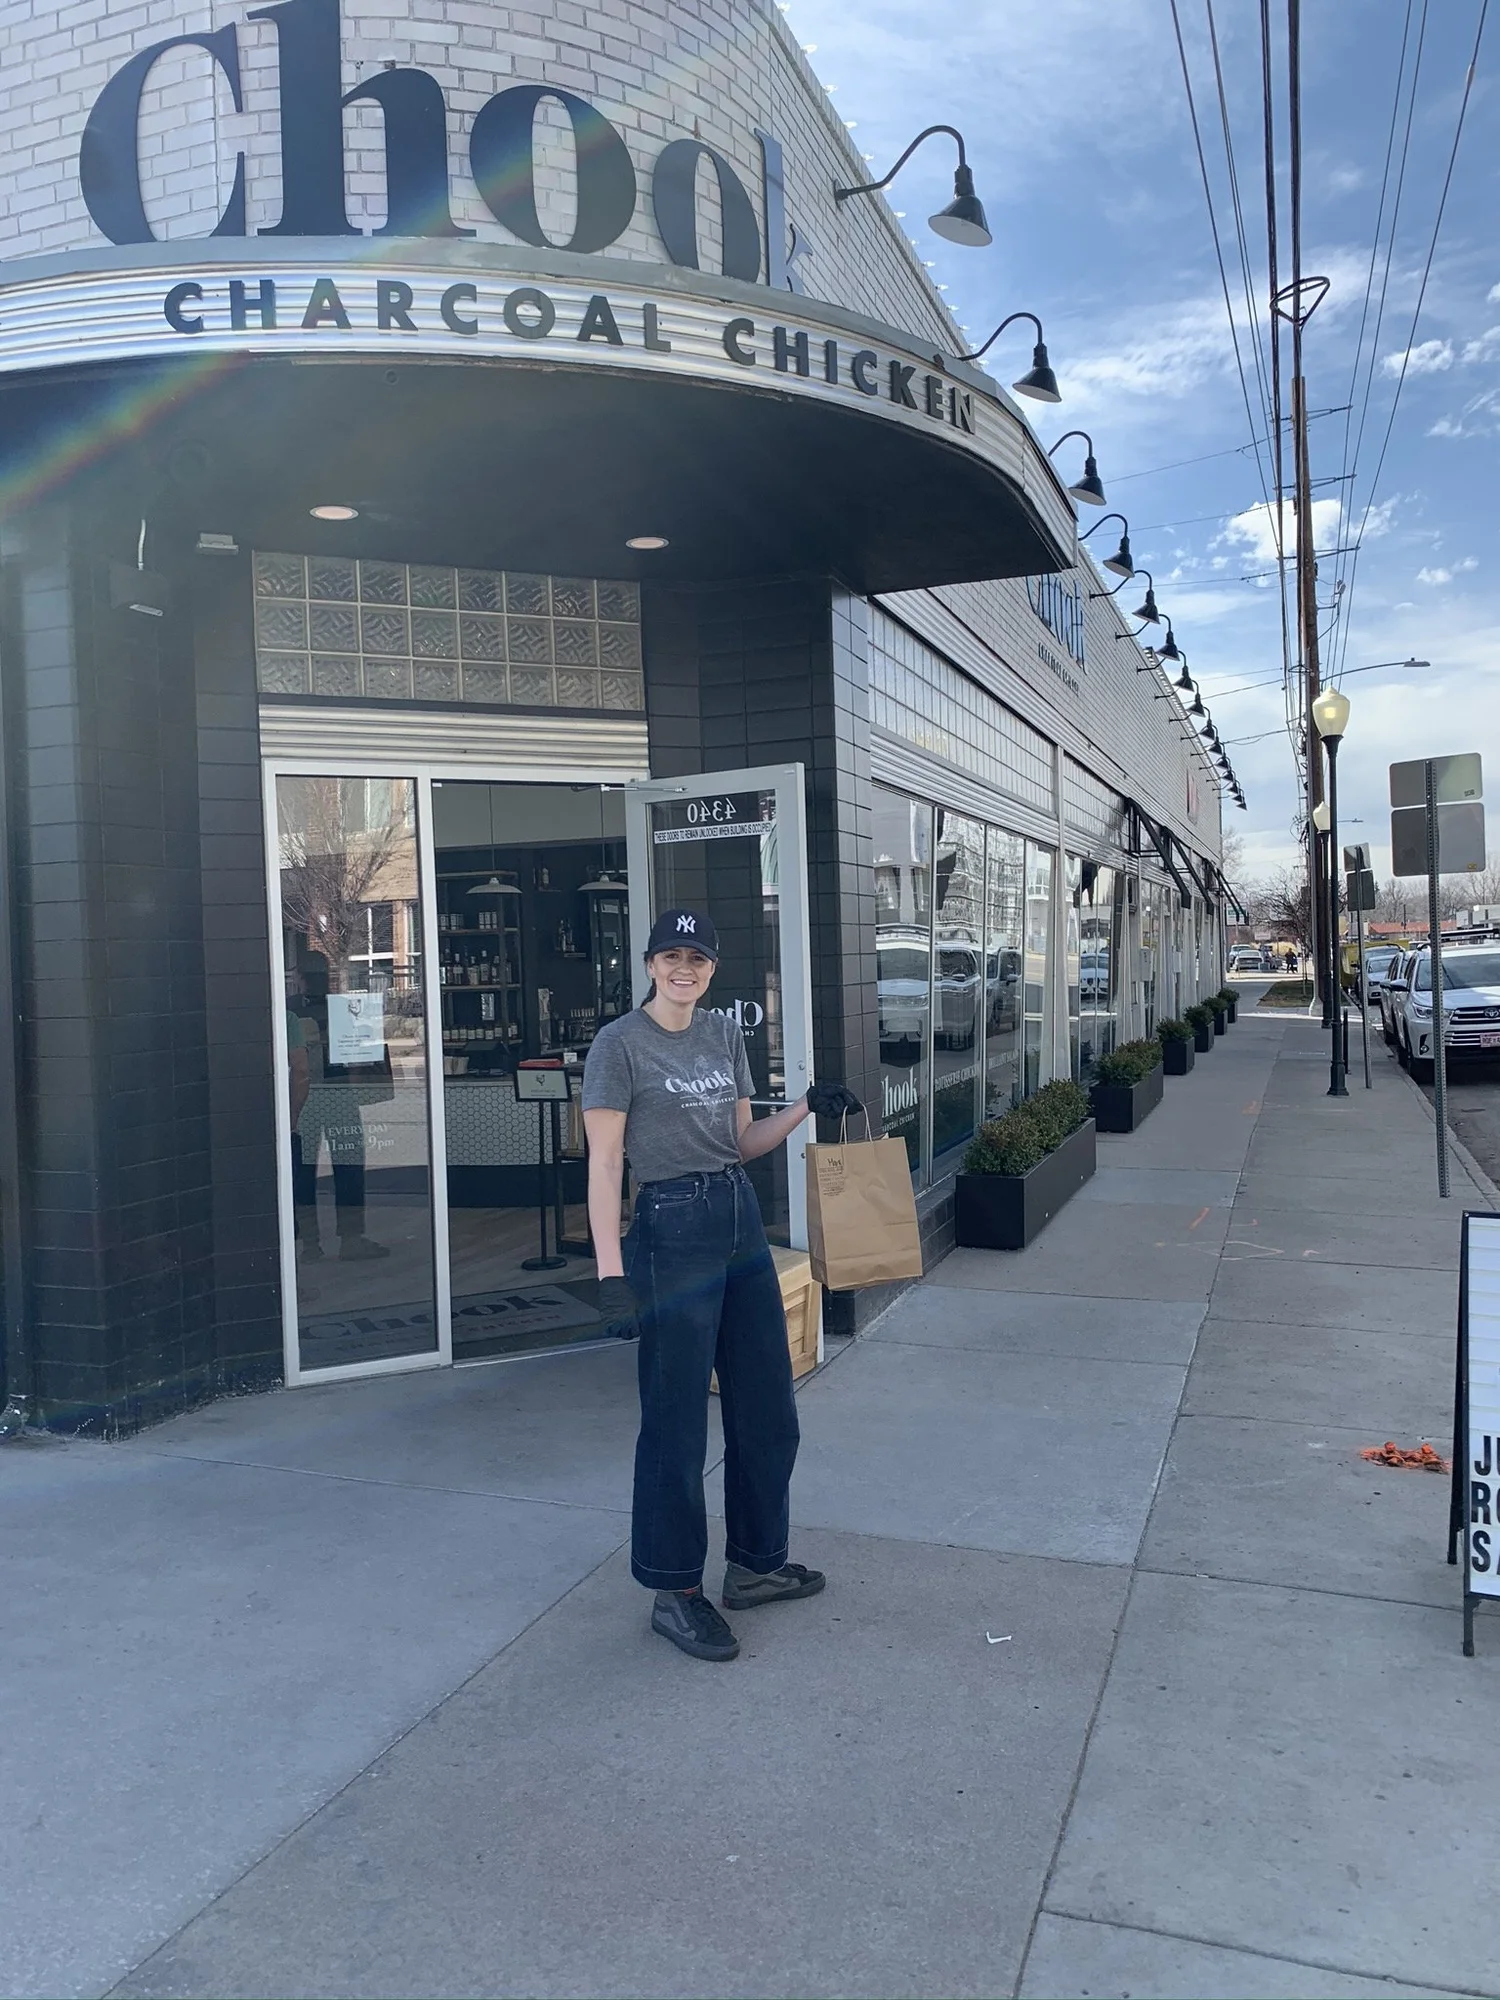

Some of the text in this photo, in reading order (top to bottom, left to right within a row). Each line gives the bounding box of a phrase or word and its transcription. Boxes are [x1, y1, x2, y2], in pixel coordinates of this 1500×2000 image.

[80, 0, 814, 293] Chook
[164, 278, 976, 435] CHARCOAL CHICKEN
[880, 1066, 918, 1118] hook
